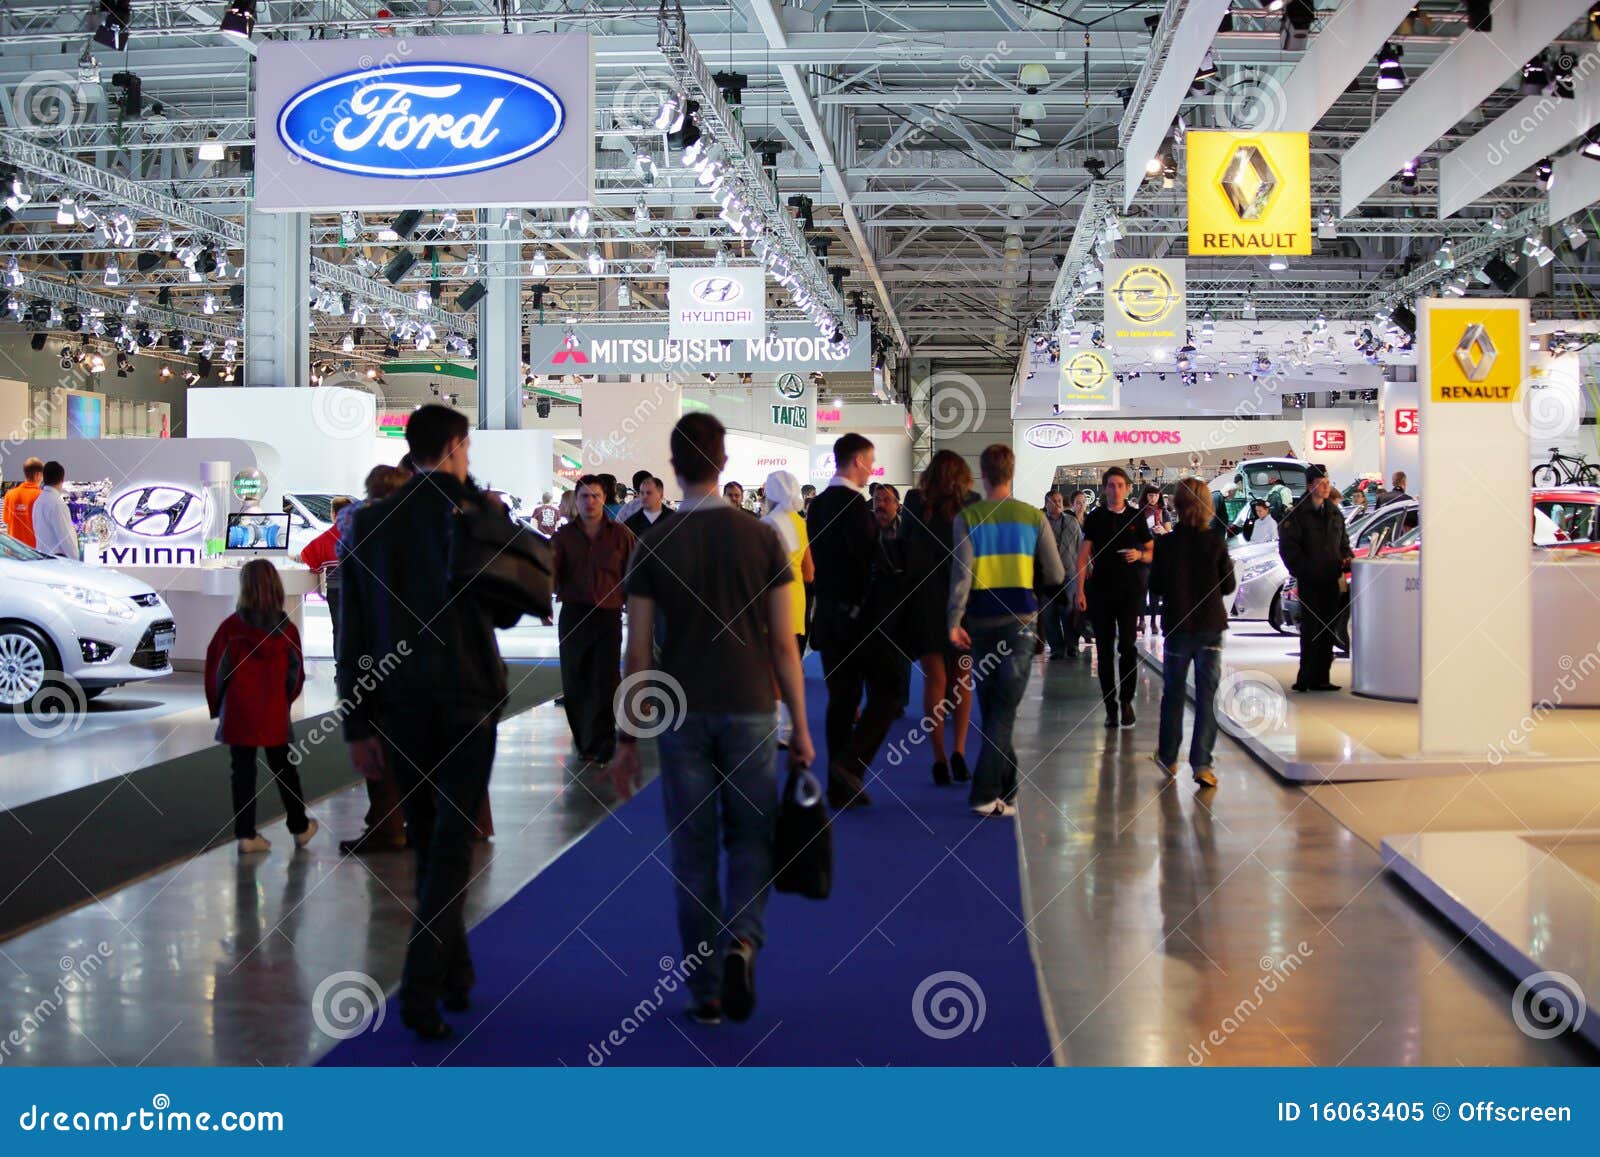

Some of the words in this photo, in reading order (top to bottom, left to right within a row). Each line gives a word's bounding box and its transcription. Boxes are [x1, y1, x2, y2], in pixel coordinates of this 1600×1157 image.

[333, 82, 504, 152] Ford
[1203, 233, 1297, 248] RENAULT
[681, 311, 751, 322] HYUNDAI
[591, 338, 731, 363] MITSUBISHI
[1440, 386, 1511, 399] RENAULT
[771, 404, 808, 429] ТАГАЗ
[1397, 410, 1413, 433] 5
[1081, 430, 1110, 444] KIA
[1113, 430, 1182, 444] MOTORS
[1315, 431, 1327, 449] 5
